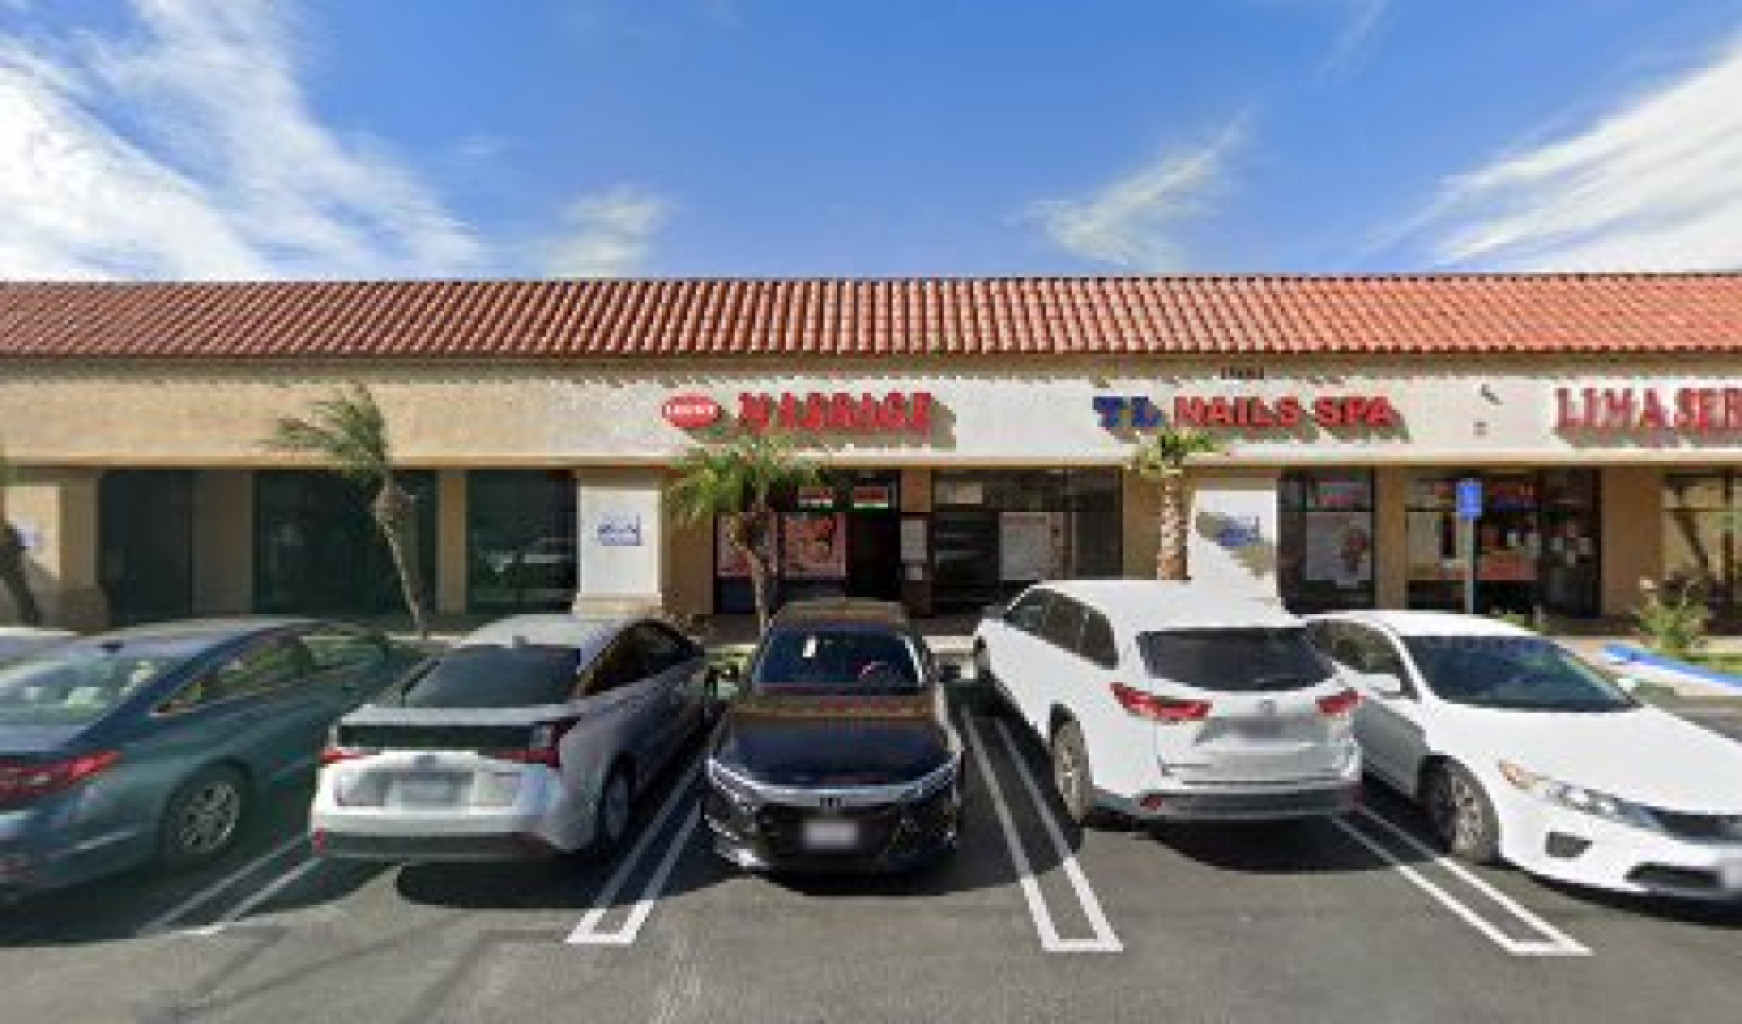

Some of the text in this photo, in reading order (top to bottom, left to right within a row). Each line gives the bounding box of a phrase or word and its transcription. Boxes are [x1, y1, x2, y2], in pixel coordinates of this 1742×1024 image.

[738, 391, 932, 429] MASSAGE
[1174, 395, 1299, 428] NAILS
[1313, 395, 1392, 428] SPA
